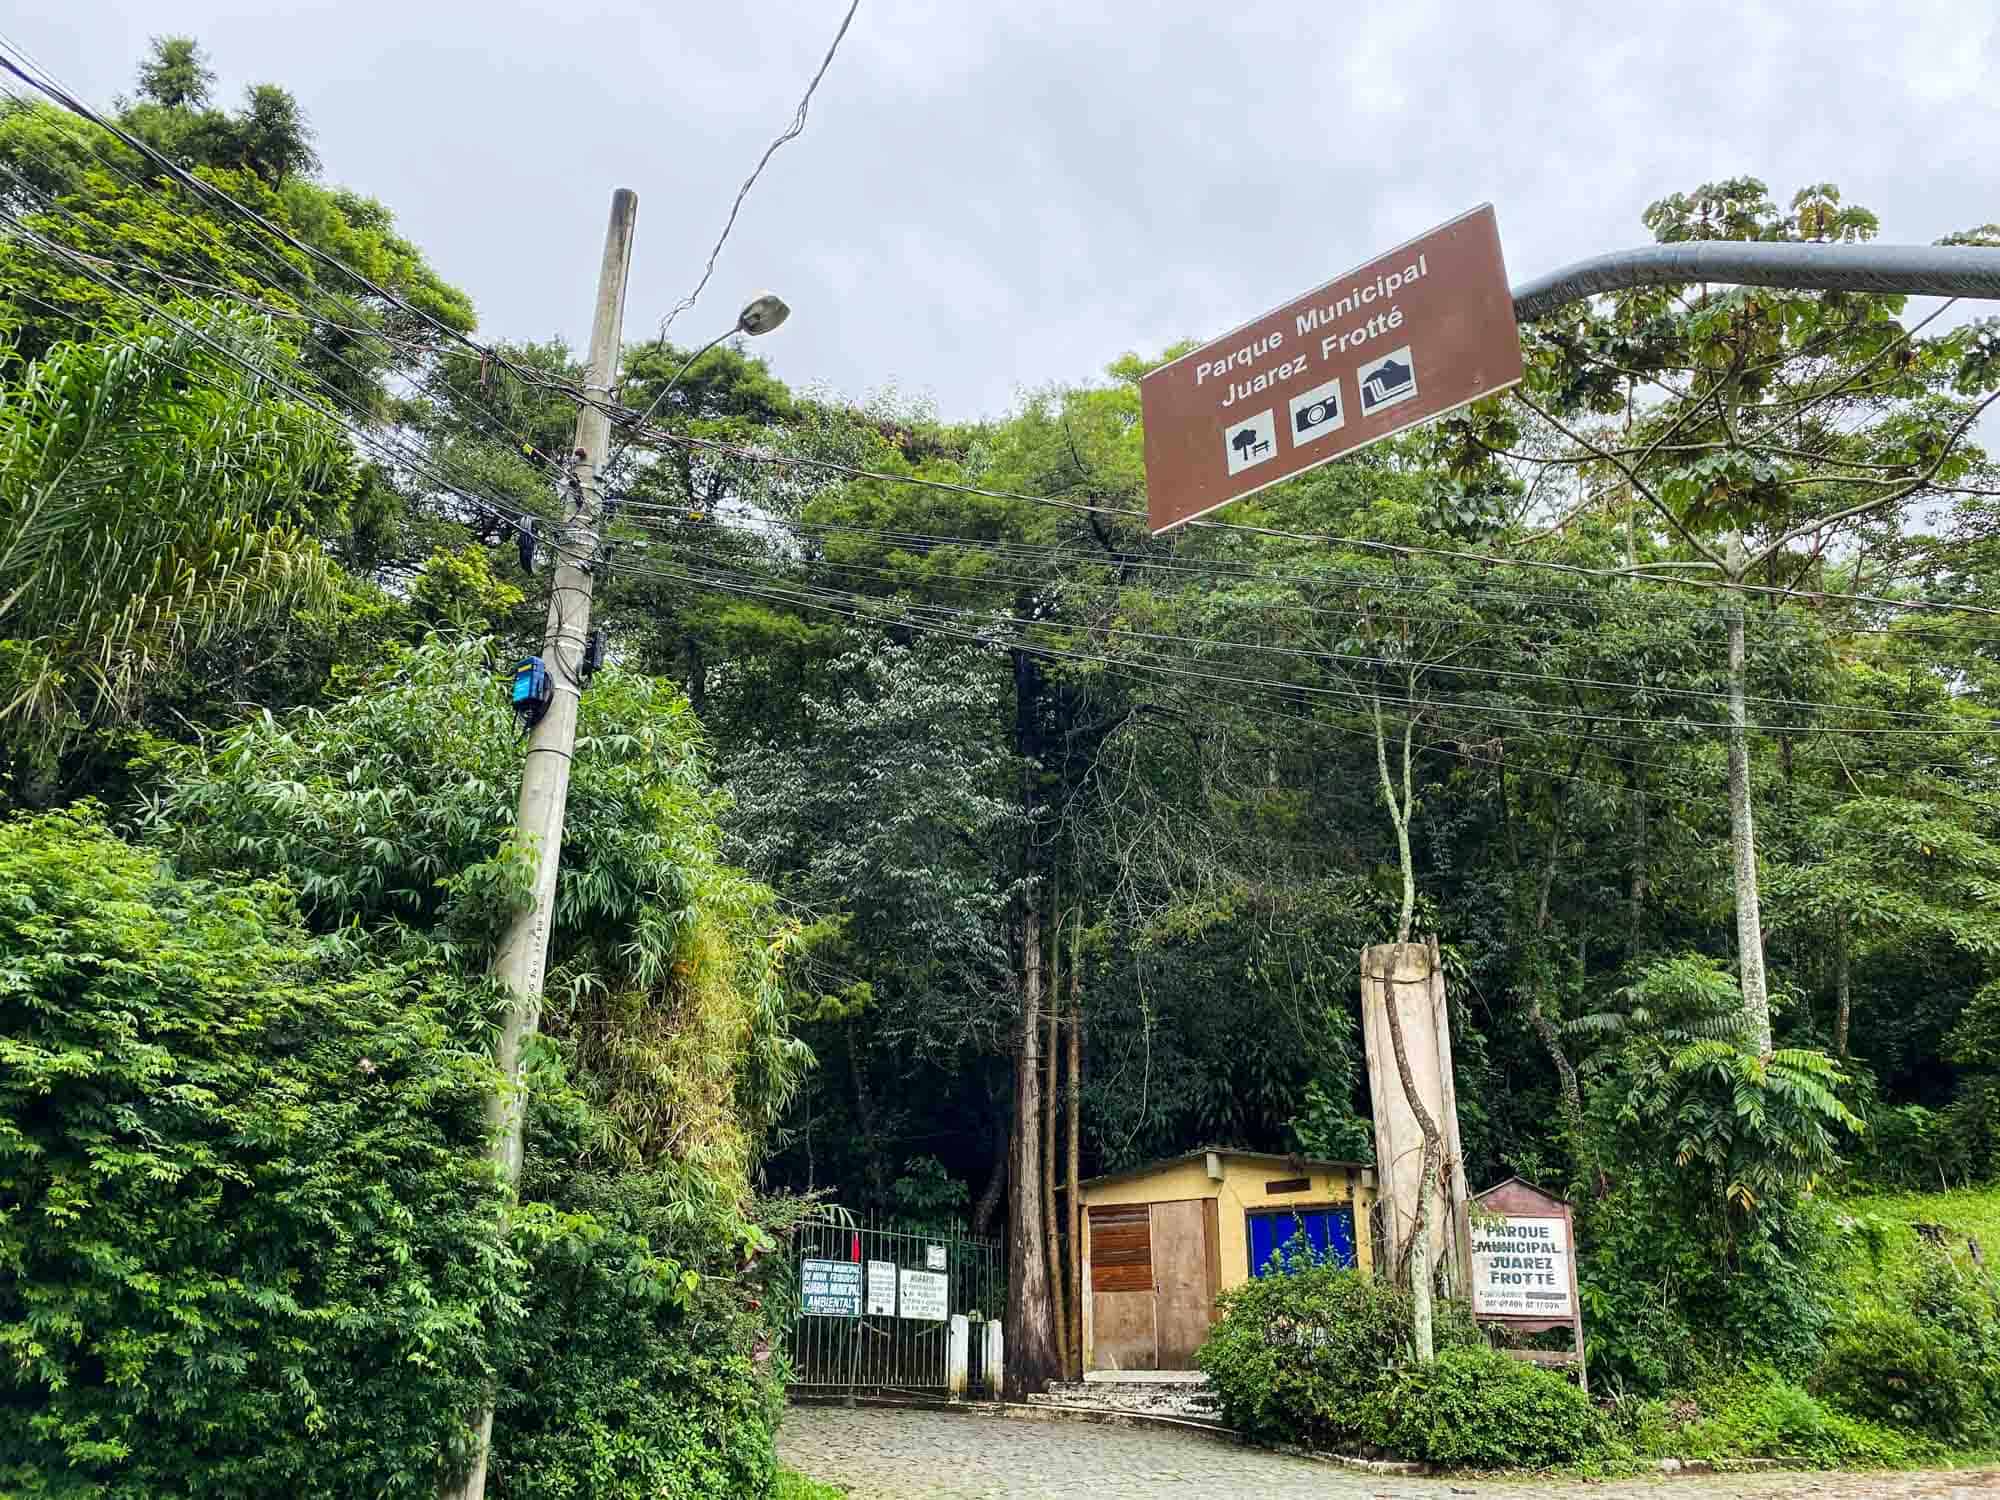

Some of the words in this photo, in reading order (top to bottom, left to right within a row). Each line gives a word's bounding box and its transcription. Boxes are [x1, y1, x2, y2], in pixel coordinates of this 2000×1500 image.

[1195, 331, 1283, 385] Parque
[1295, 254, 1428, 336] Municipal
[1221, 353, 1308, 407] Juarez
[1320, 304, 1404, 360] Frotté
[1486, 1225, 1549, 1239] PARQUE
[1476, 1241, 1561, 1254] MUNICIPAL
[1489, 1257, 1553, 1270] JUAREZ
